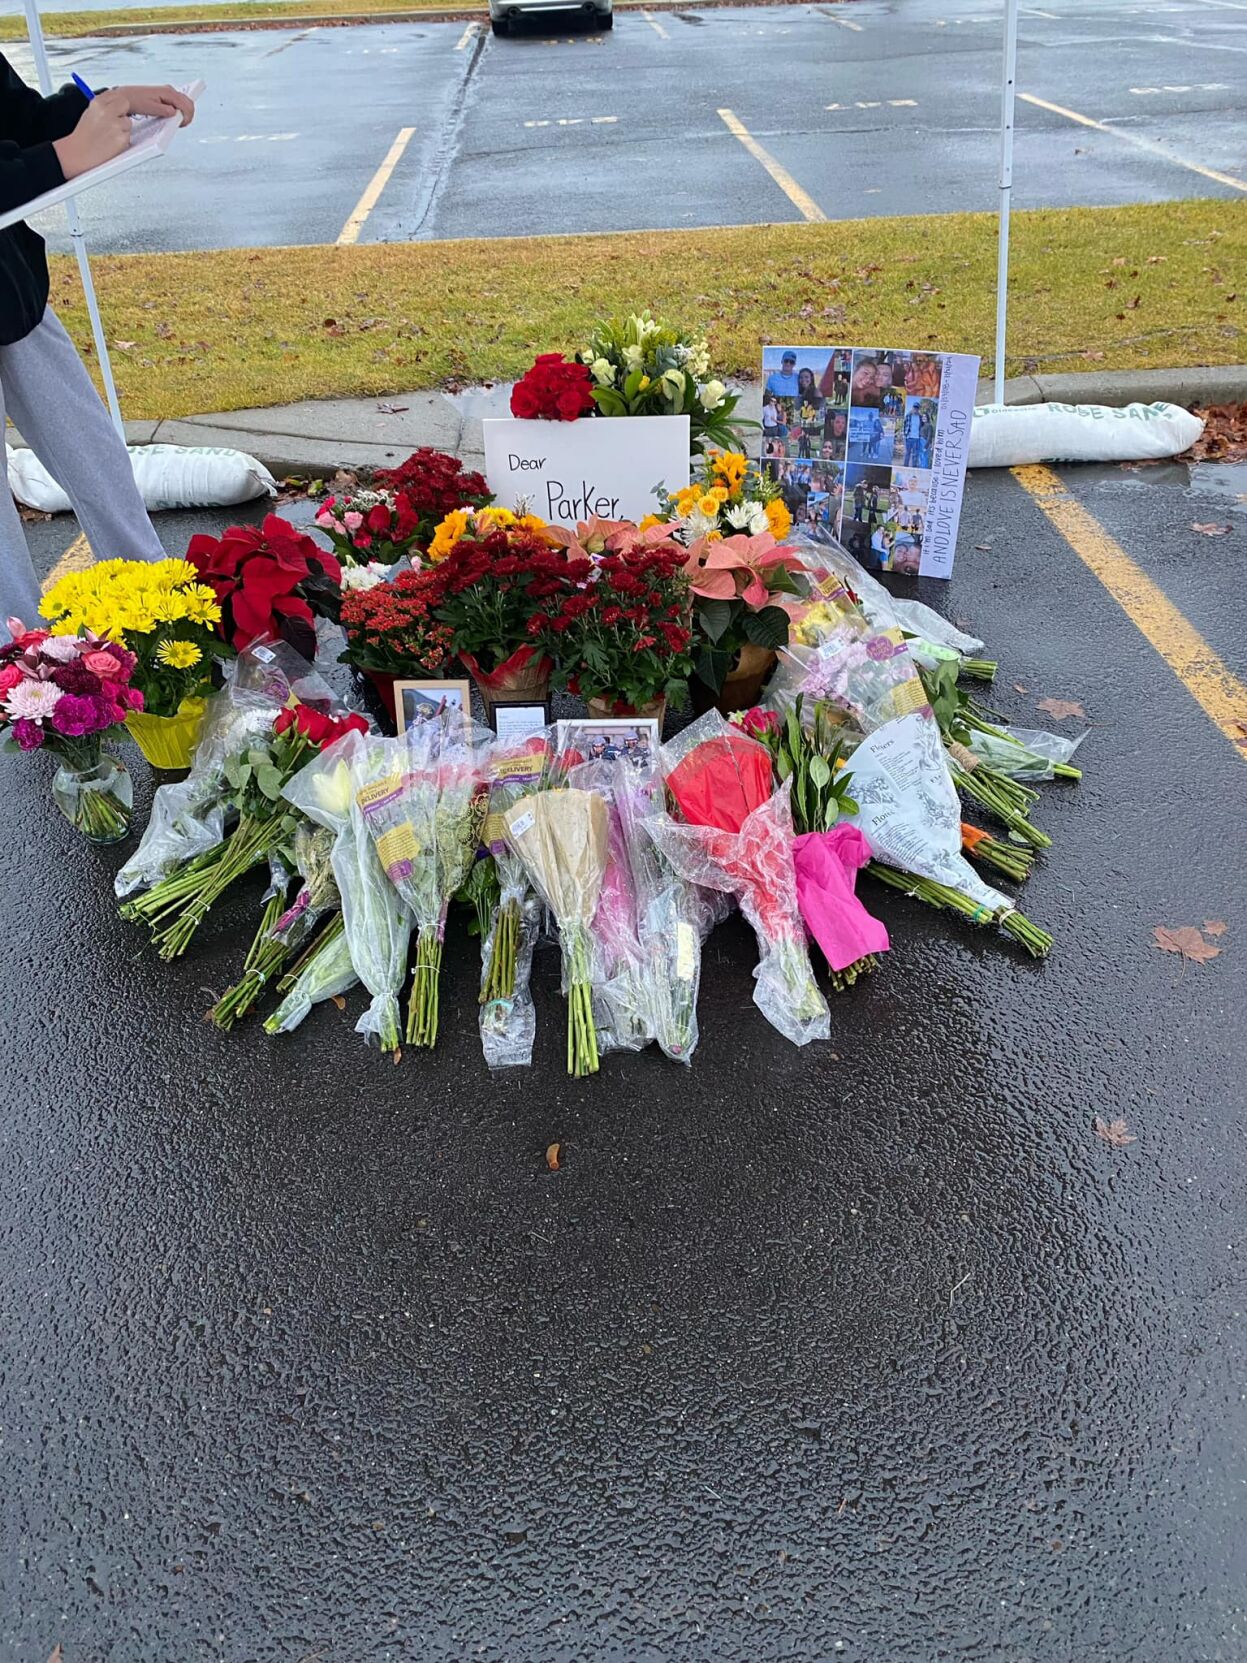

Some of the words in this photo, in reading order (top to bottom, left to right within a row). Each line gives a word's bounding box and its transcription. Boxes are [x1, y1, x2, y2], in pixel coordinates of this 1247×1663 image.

[947, 409, 967, 436] SAD
[936, 428, 945, 445] him
[508, 453, 547, 471] Dear
[933, 447, 943, 468] loved
[941, 438, 962, 487] NEVER
[546, 480, 624, 522] Parker,
[929, 477, 939, 504] because
[940, 490, 957, 502] IS
[936, 506, 954, 536] LOVE
[932, 536, 950, 564] AND
